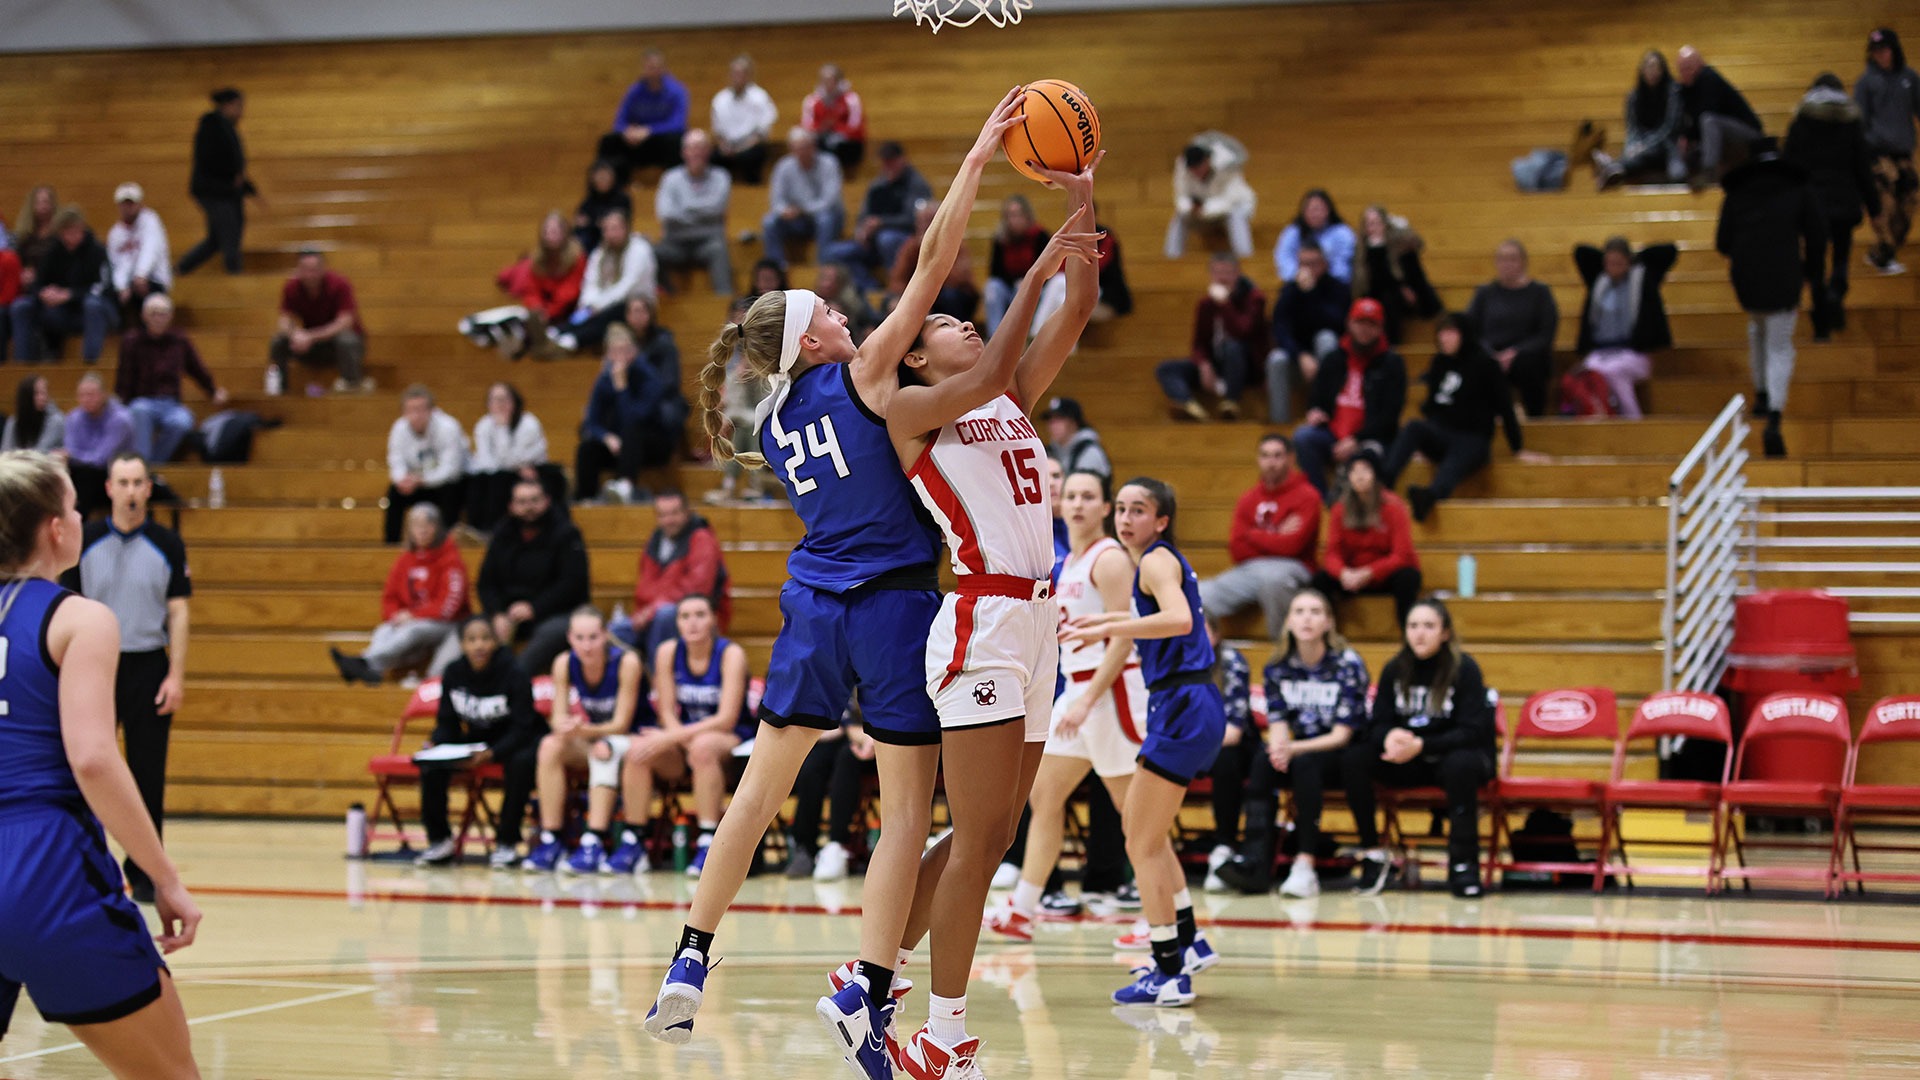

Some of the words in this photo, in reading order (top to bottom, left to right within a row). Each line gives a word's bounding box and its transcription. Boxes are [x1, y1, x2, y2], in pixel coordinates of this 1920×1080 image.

[1061, 92, 1095, 156] Wilson
[955, 416, 1037, 445] CORTLAN
[777, 412, 851, 497] 24
[1000, 447, 1043, 506] 15
[1641, 696, 1719, 721] CORTLAND
[1761, 697, 1839, 723] CORTLAND
